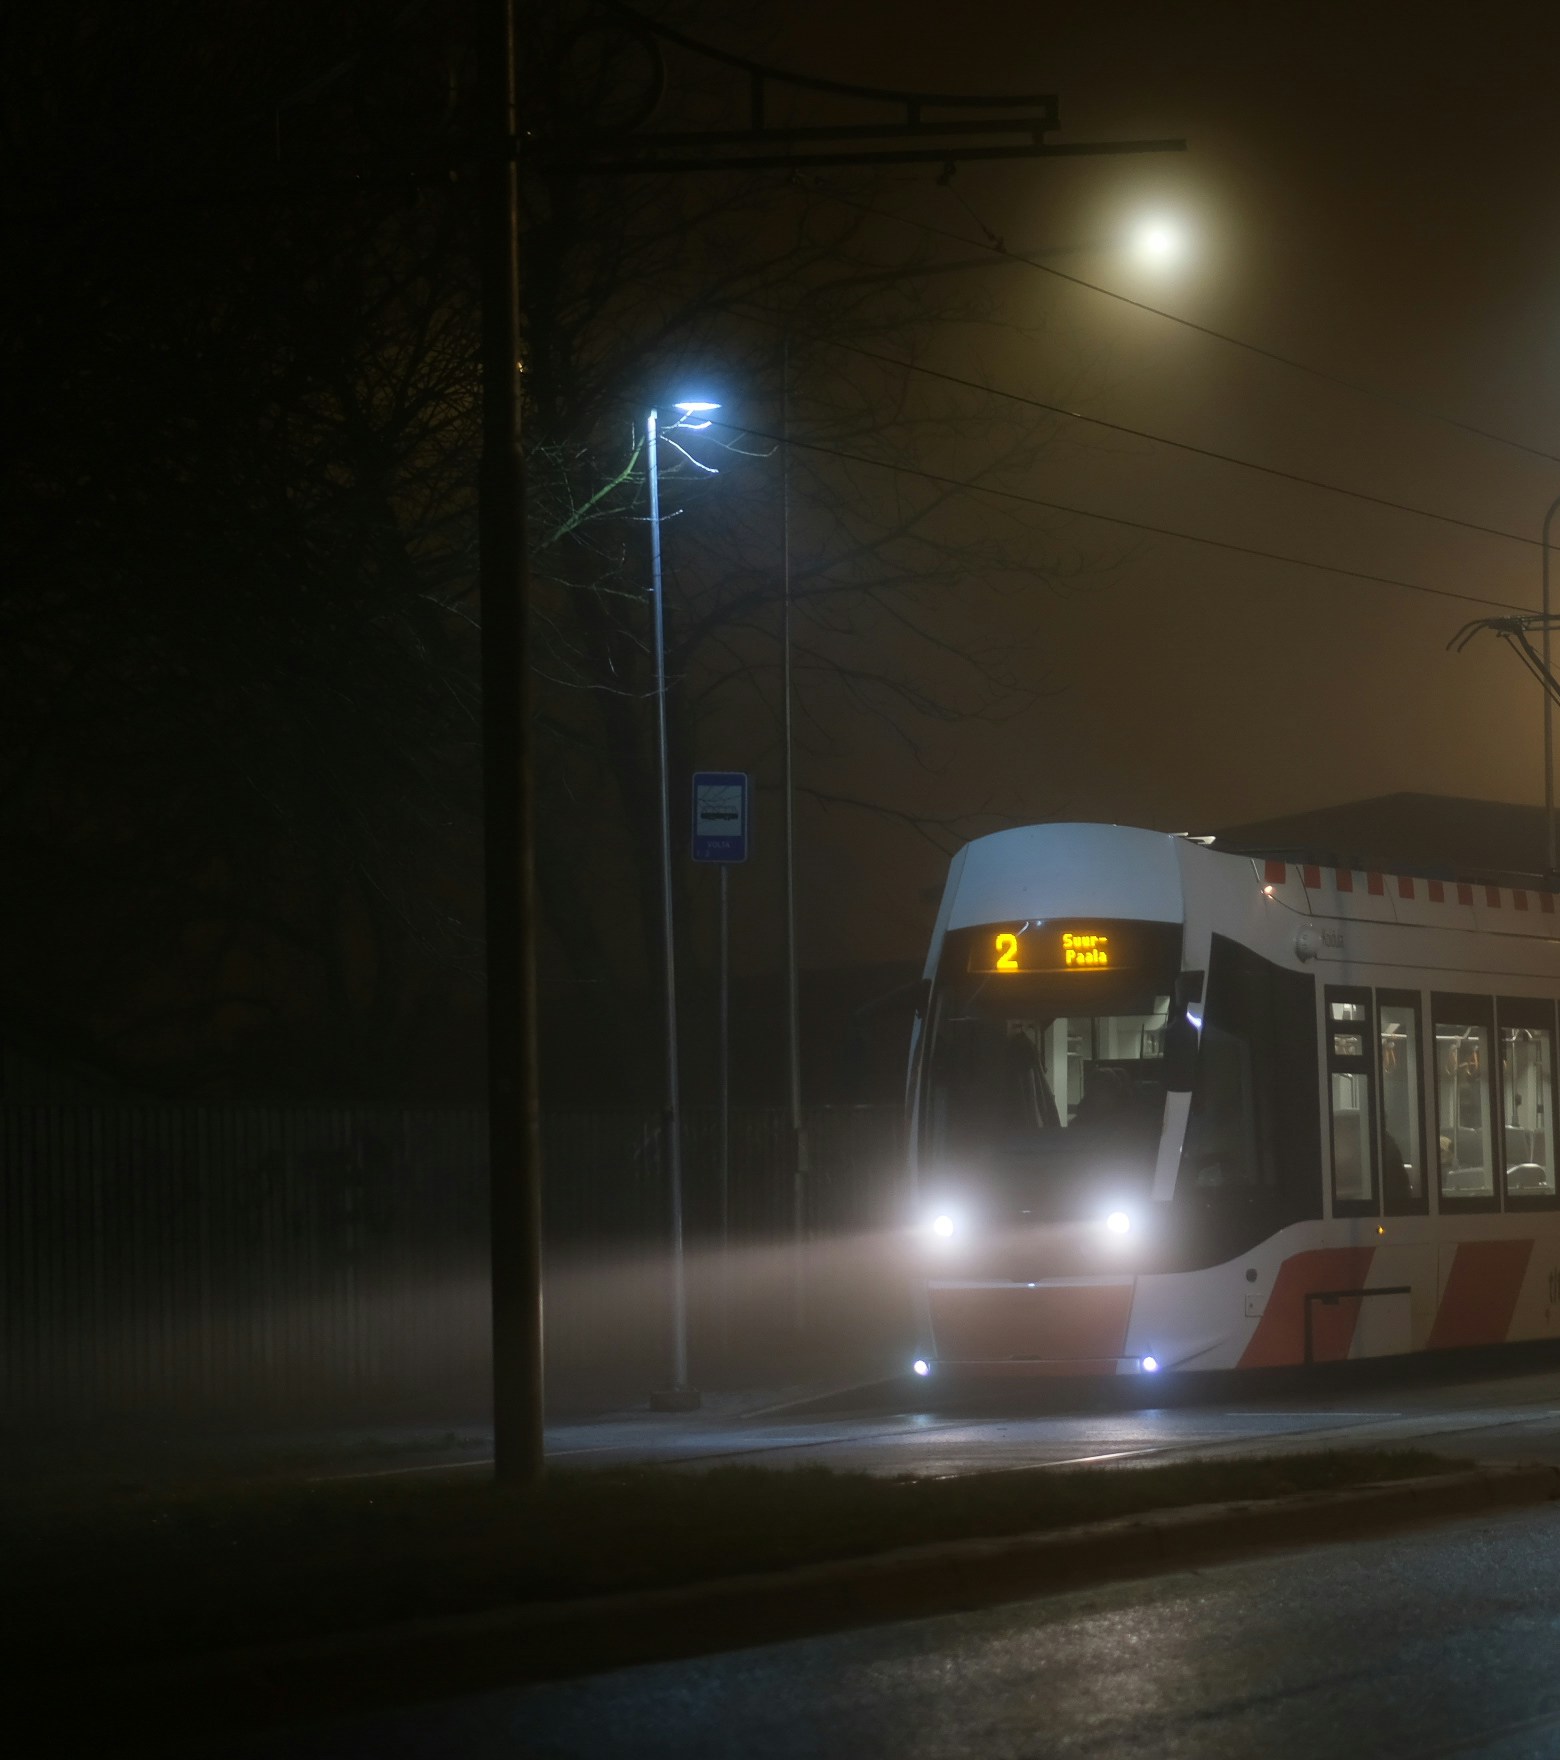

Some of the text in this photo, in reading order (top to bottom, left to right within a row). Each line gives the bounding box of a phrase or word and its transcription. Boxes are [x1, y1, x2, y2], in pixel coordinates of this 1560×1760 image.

[706, 840, 731, 849] VOLTA
[1062, 933, 1108, 948] Suur-
[995, 933, 1019, 969] 2
[1065, 949, 1108, 966] Paala
